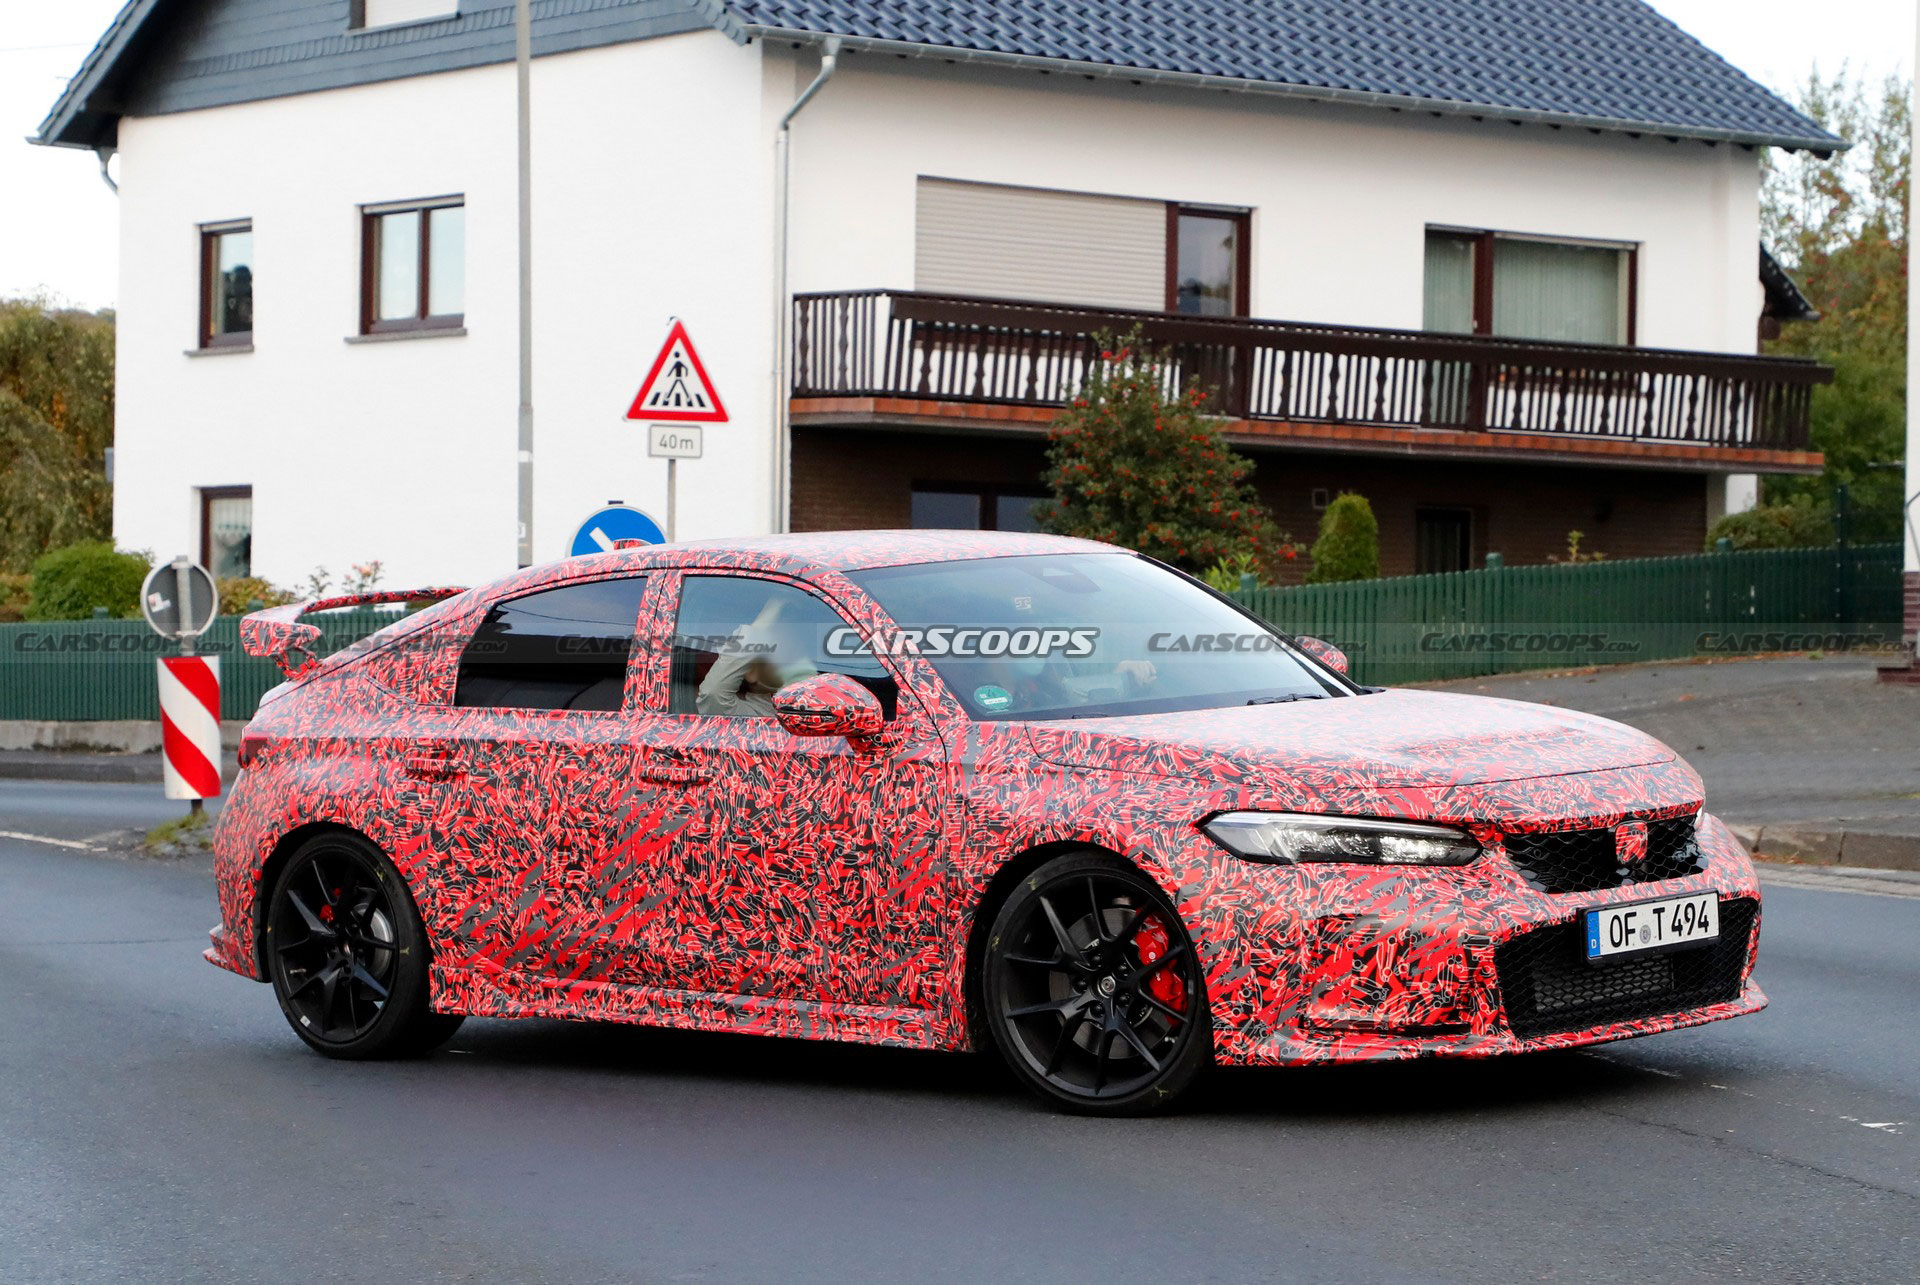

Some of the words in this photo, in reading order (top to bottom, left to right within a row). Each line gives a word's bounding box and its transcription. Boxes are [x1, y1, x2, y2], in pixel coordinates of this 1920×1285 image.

[1610, 911, 1637, 948] OF
[1671, 900, 1710, 937] 494
[1591, 938, 1597, 949] D
